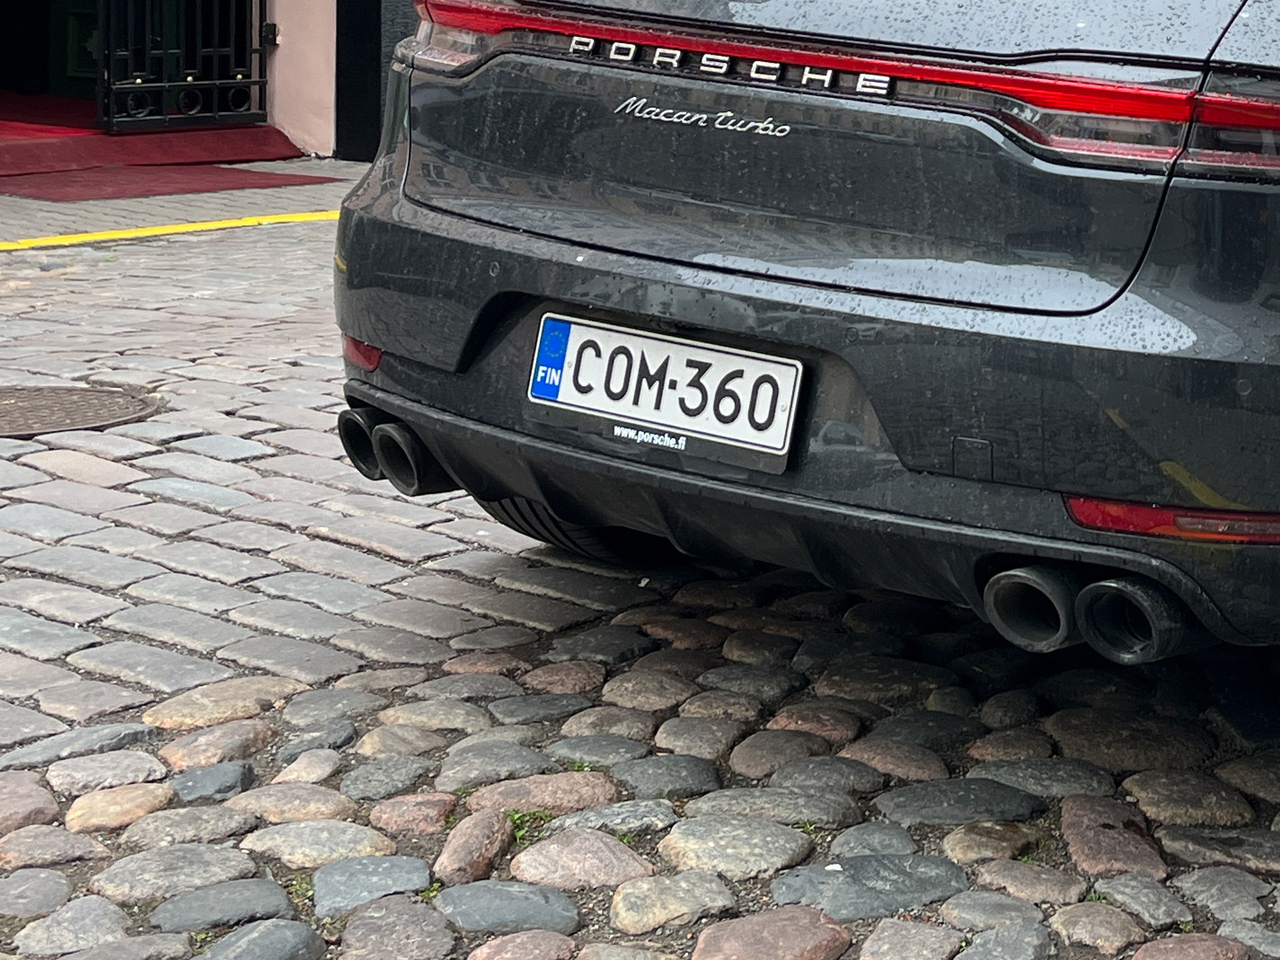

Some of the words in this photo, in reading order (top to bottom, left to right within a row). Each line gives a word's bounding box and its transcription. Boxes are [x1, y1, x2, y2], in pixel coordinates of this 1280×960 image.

[568, 36, 891, 95] PORSCHE
[614, 96, 708, 127] Macan
[537, 365, 562, 387] FIN
[571, 339, 780, 432] COM-360
[613, 424, 687, 451] www.porsche.fi
